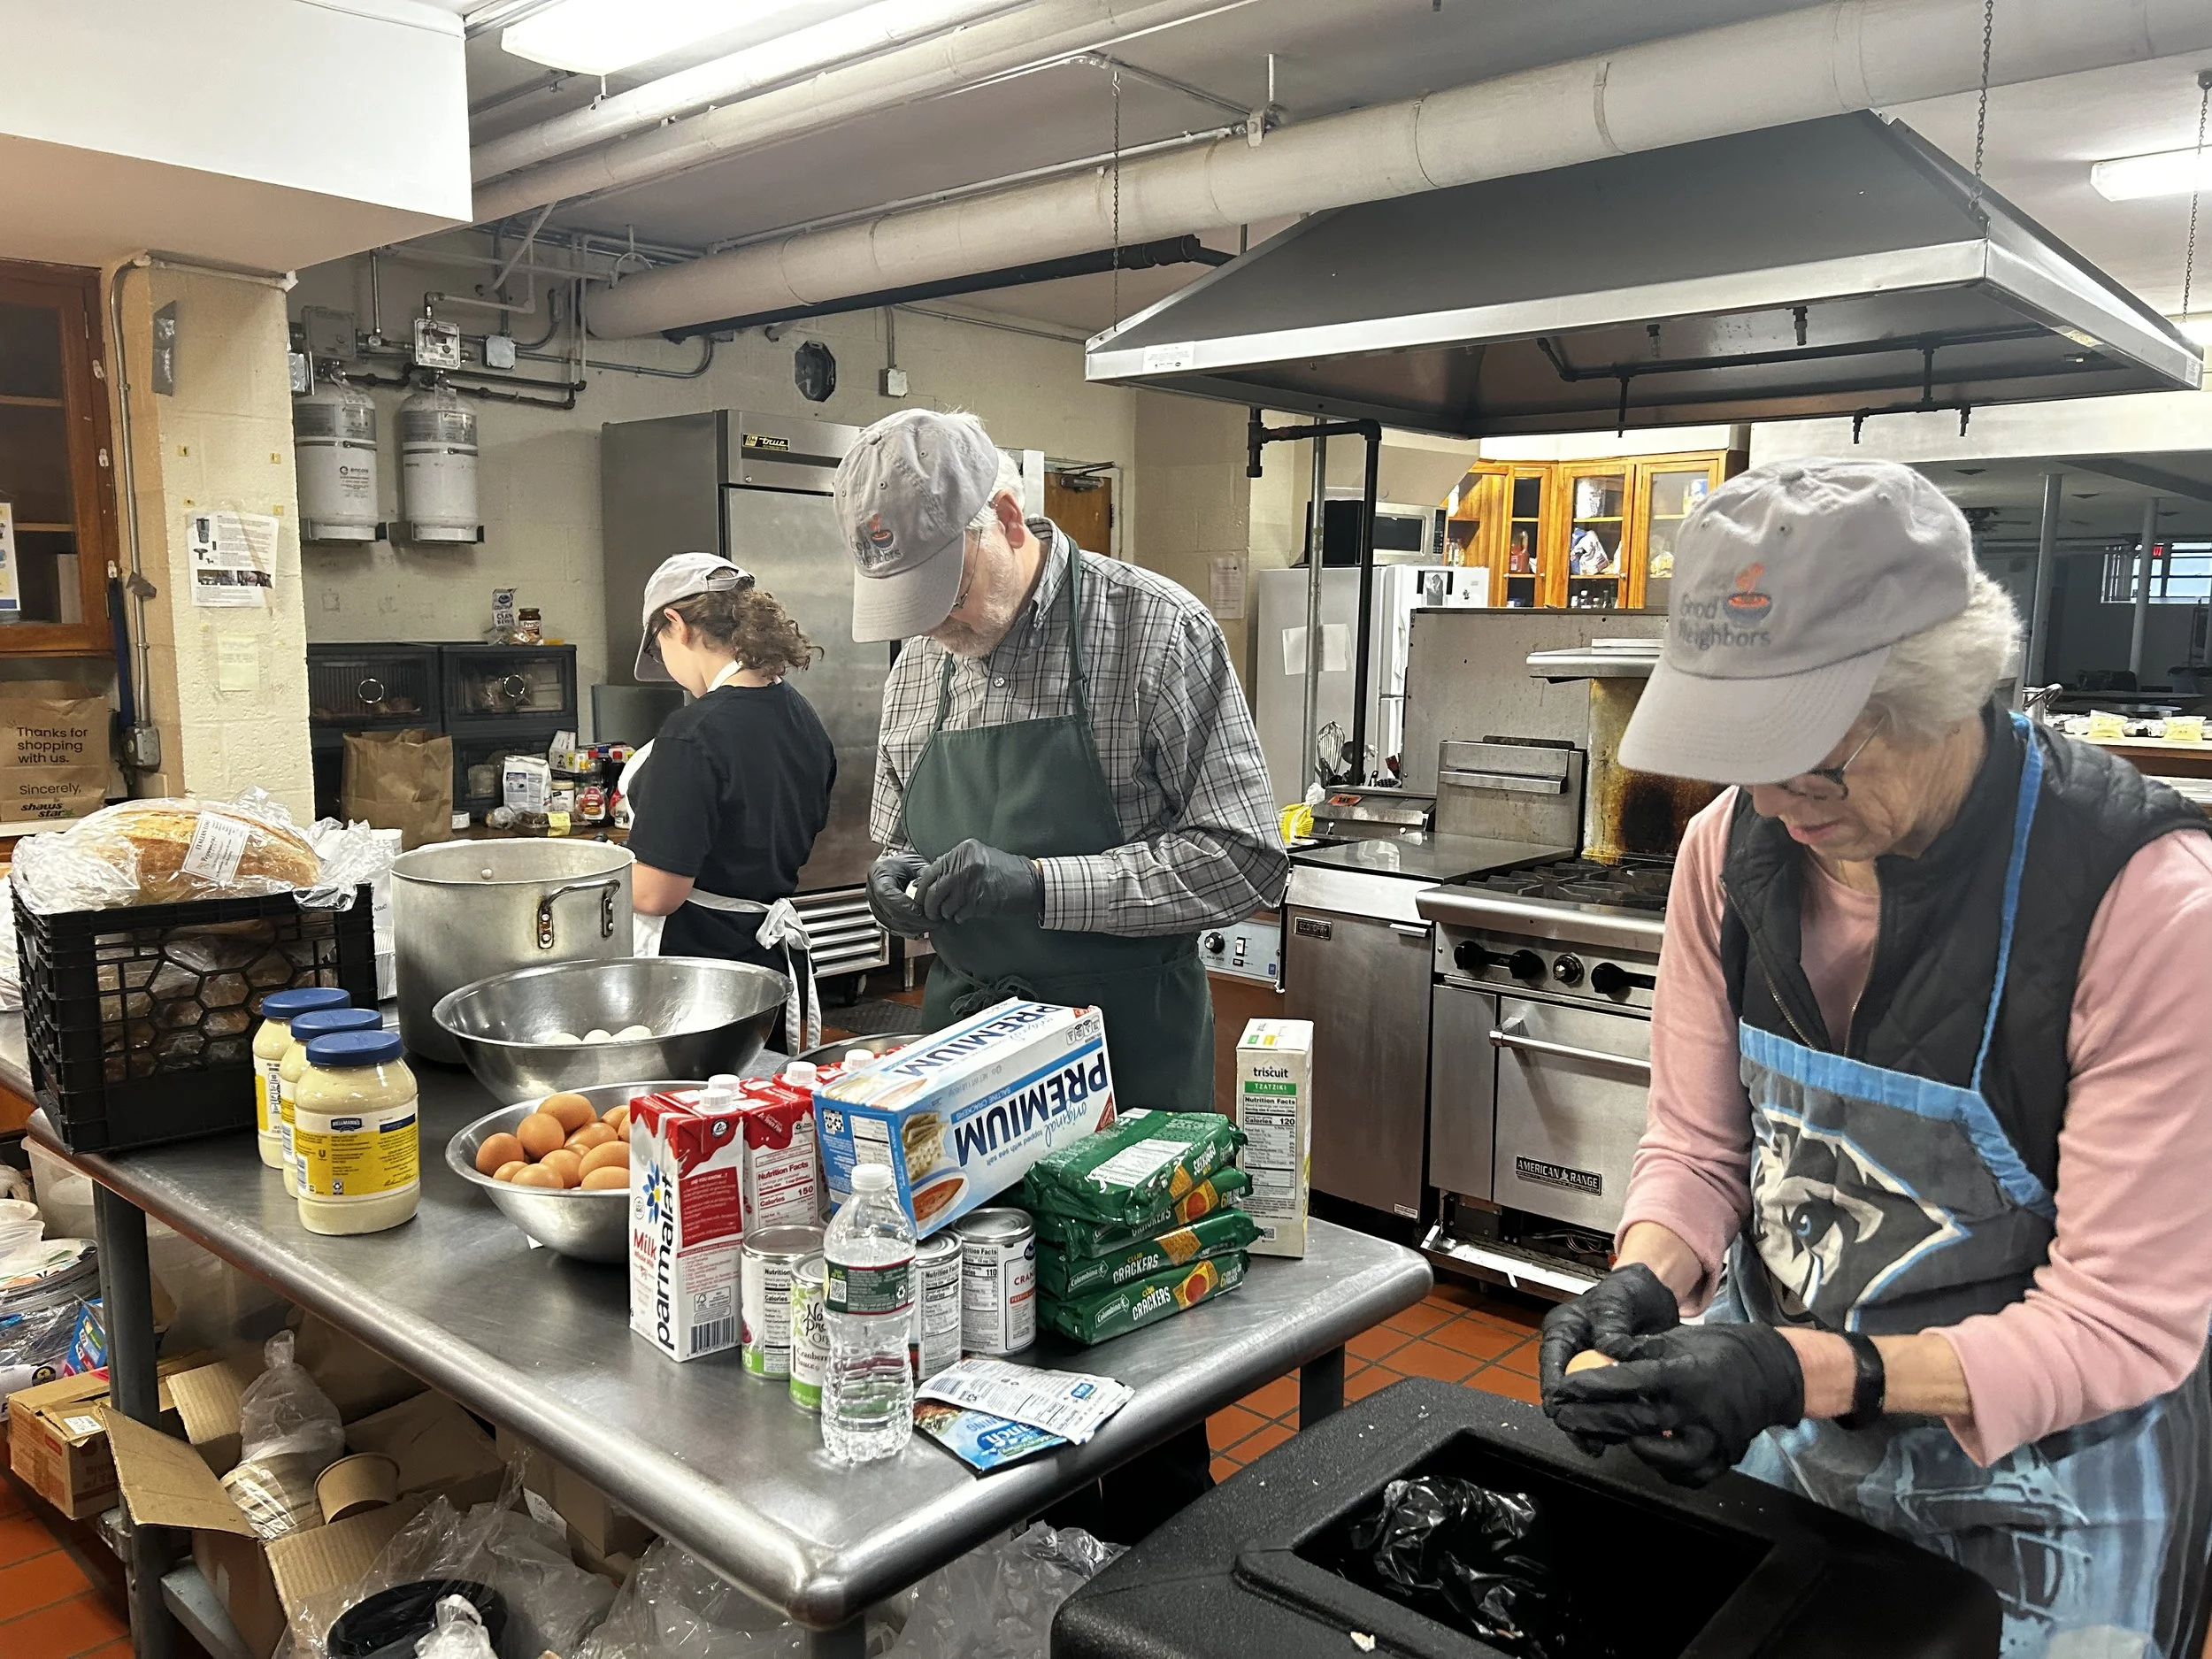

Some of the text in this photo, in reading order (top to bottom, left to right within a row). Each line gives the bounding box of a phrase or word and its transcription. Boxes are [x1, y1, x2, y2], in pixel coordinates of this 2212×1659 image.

[759, 436, 785, 446] true
[1679, 594, 1720, 619] Good
[1678, 619, 1771, 651] Neighbors
[17, 726, 88, 738] Thanks for
[18, 740, 83, 753] shopping
[18, 753, 46, 764] with
[19, 783, 81, 795] Sincerely,
[21, 803, 64, 811] shaws
[894, 1004, 1064, 1077] PREMIUM
[1253, 1065, 1288, 1078] triscuit
[954, 1051, 1109, 1168] PREMIUM
[956, 1086, 1011, 1121] SALTINE CRACKERS
[1044, 1098, 1087, 1148] original
[987, 1130, 1043, 1166] topped with sea salt
[758, 1161, 809, 1180] Nutrition Facts
[1517, 1159, 1560, 1179] AMERICAN
[1570, 1172, 1598, 1188] RANGE
[759, 1185, 814, 1208] Calories 150
[634, 1227, 657, 1261] Milk
[656, 1172, 675, 1351] parmalat
[1126, 1252, 1143, 1263] CLUB
[926, 1268, 949, 1279] Nutrition
[986, 1268, 997, 1277] 110
[1112, 1254, 1159, 1285] CRACKERS
[1142, 1285, 1155, 1298] CLUB
[806, 1302, 824, 1322] Na
[1132, 1286, 1171, 1321] CRACKERS
[796, 1348, 828, 1363] Cranberr
[796, 1357, 815, 1369] Sauce
